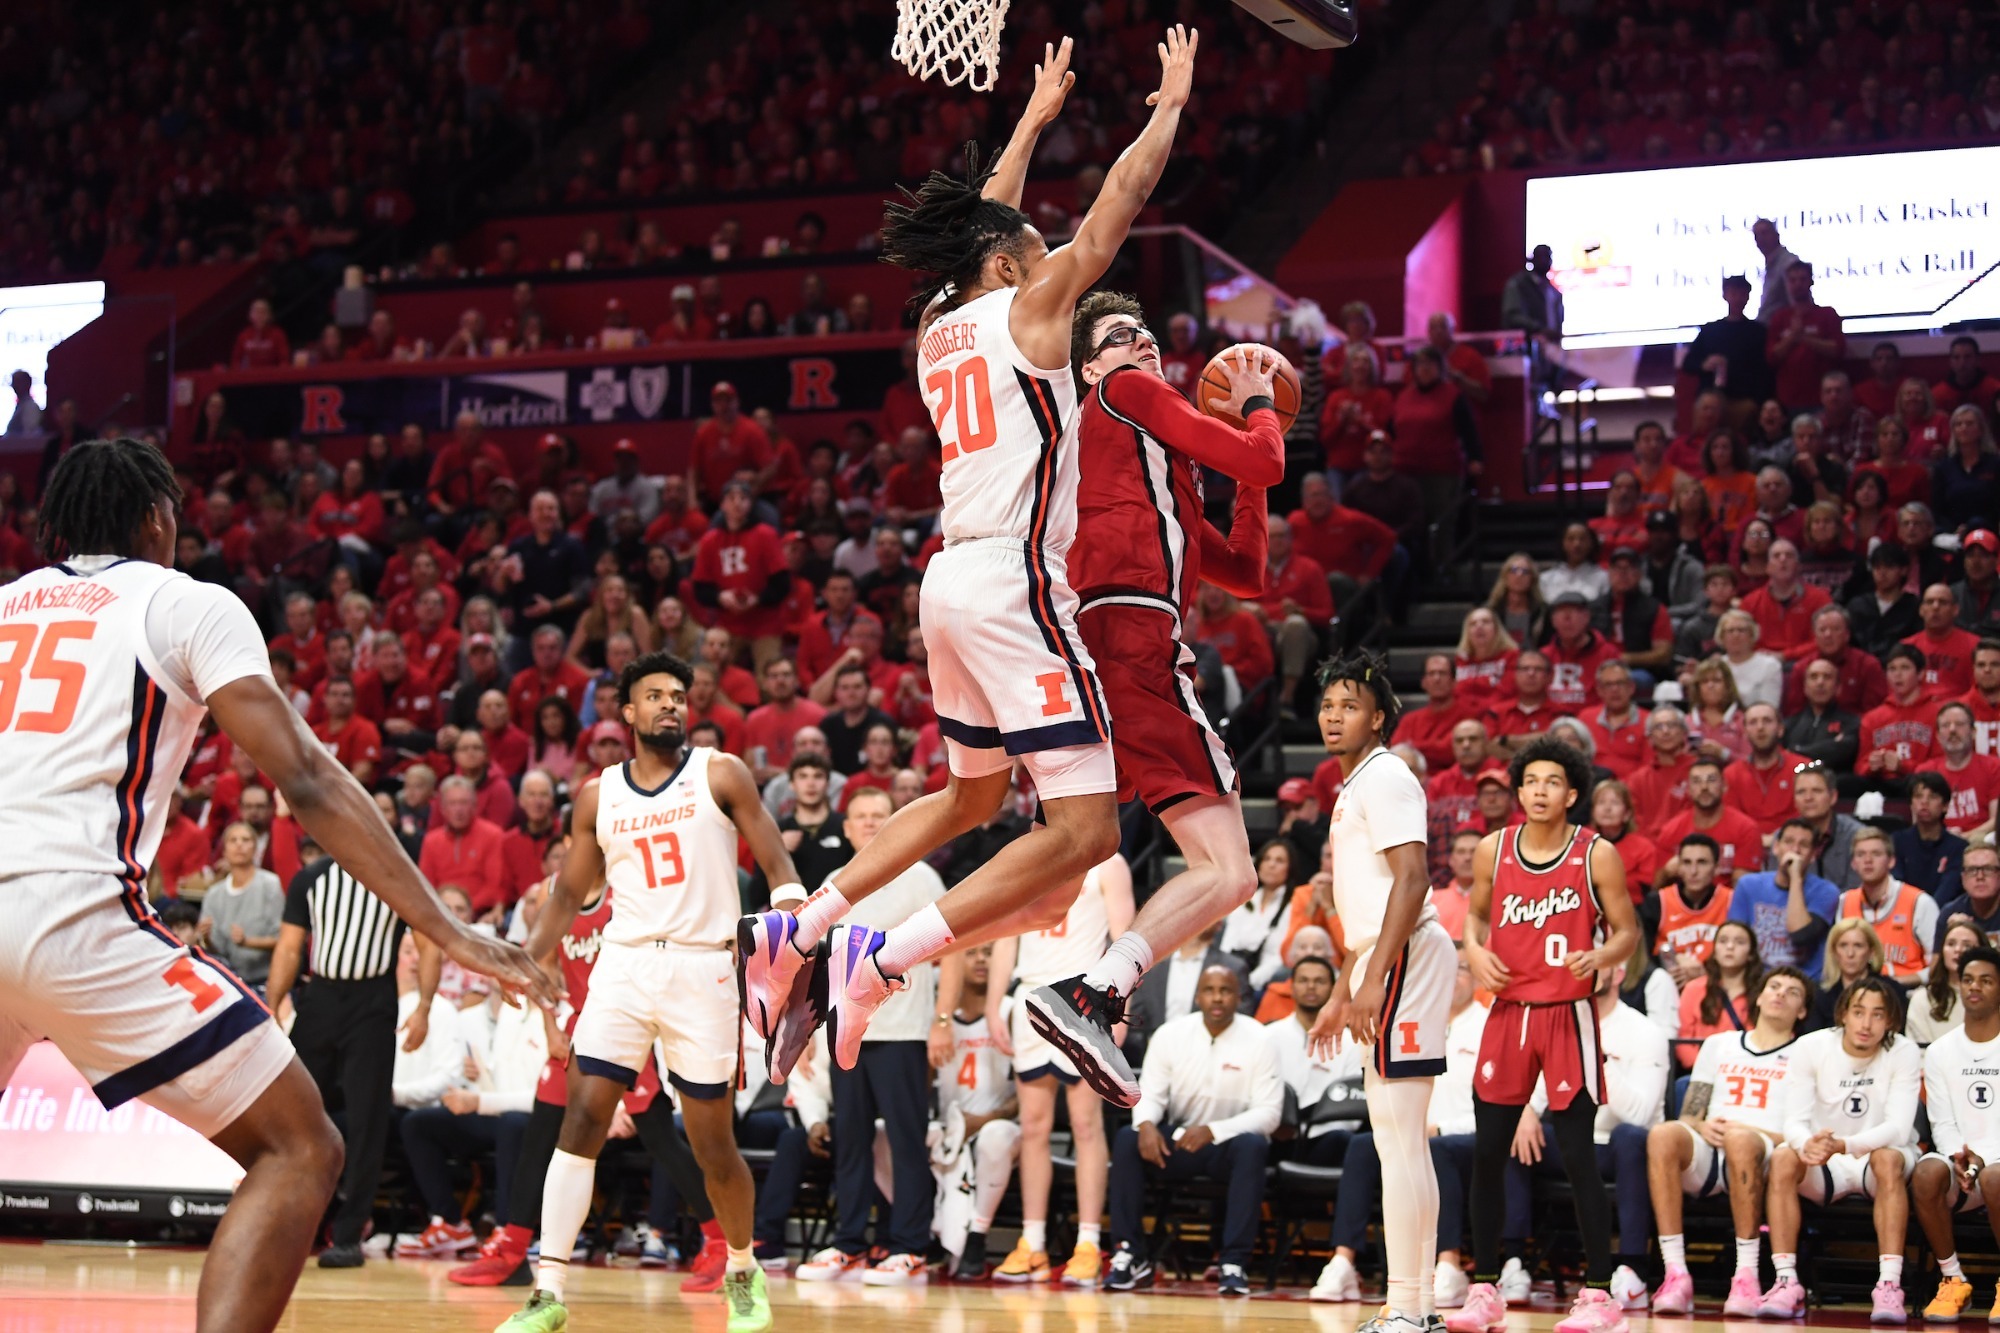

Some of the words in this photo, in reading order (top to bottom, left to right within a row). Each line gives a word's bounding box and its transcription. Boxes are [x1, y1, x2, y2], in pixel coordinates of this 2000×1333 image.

[1800, 203, 1864, 228] Bowl
[1873, 204, 1890, 224] &
[1902, 197, 1990, 222] Basket
[1811, 256, 1885, 281] asket
[1925, 249, 1974, 274] Ball
[920, 322, 978, 367] RODGERS
[790, 358, 840, 410] R
[303, 384, 346, 434] R
[459, 394, 568, 427] Horizon
[926, 356, 998, 465] 20
[719, 546, 749, 577] R
[3, 581, 120, 620] HANSBERRY
[0, 620, 98, 735] 35
[1552, 663, 1584, 691] R
[612, 803, 697, 835] ILLINOIS
[633, 831, 686, 889] 13
[1498, 886, 1581, 929] Knights
[561, 927, 603, 964] Knigh
[1544, 933, 1568, 967] 0
[956, 1051, 977, 1091] 4
[1717, 1062, 1787, 1081] ILLINOIS
[1838, 1077, 1875, 1089] ILLINOIS
[1960, 1067, 2000, 1077] ILLINOIS
[0, 1085, 57, 1132] Life
[64, 1086, 136, 1134] Into
[1723, 1075, 1770, 1110] 33
[5, 1194, 50, 1210] Prudential
[95, 1198, 140, 1214] Prudential
